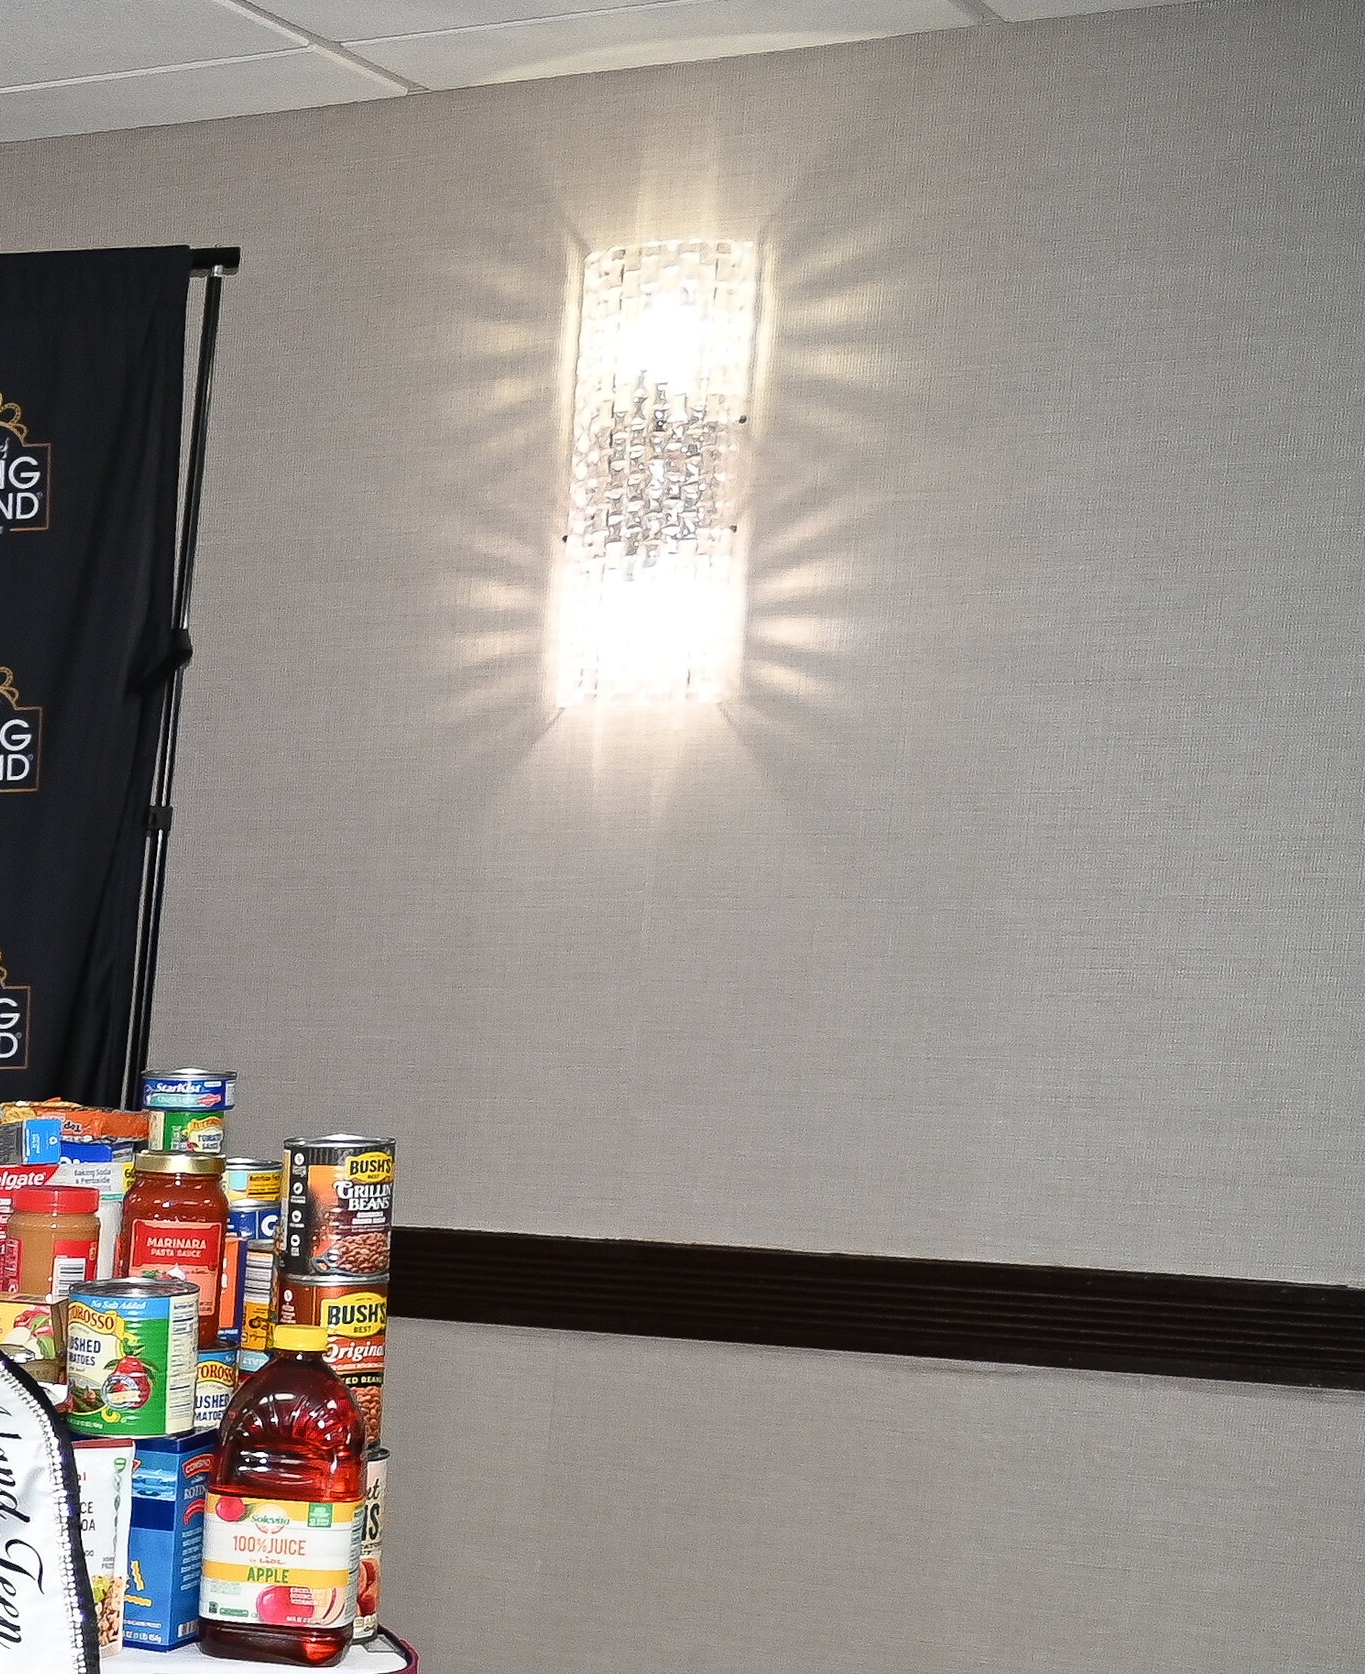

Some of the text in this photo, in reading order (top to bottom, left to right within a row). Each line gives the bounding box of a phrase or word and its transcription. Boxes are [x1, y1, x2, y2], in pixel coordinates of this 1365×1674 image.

[157, 1082, 200, 1092] StarKist
[350, 1160, 390, 1175] BUSH'S
[348, 1198, 389, 1211] BEANS
[147, 1238, 206, 1249] MARINARA
[329, 1304, 386, 1325] BUSH'S
[233, 1536, 306, 1555] 100% JUICE
[247, 1568, 289, 1584] APPLE
